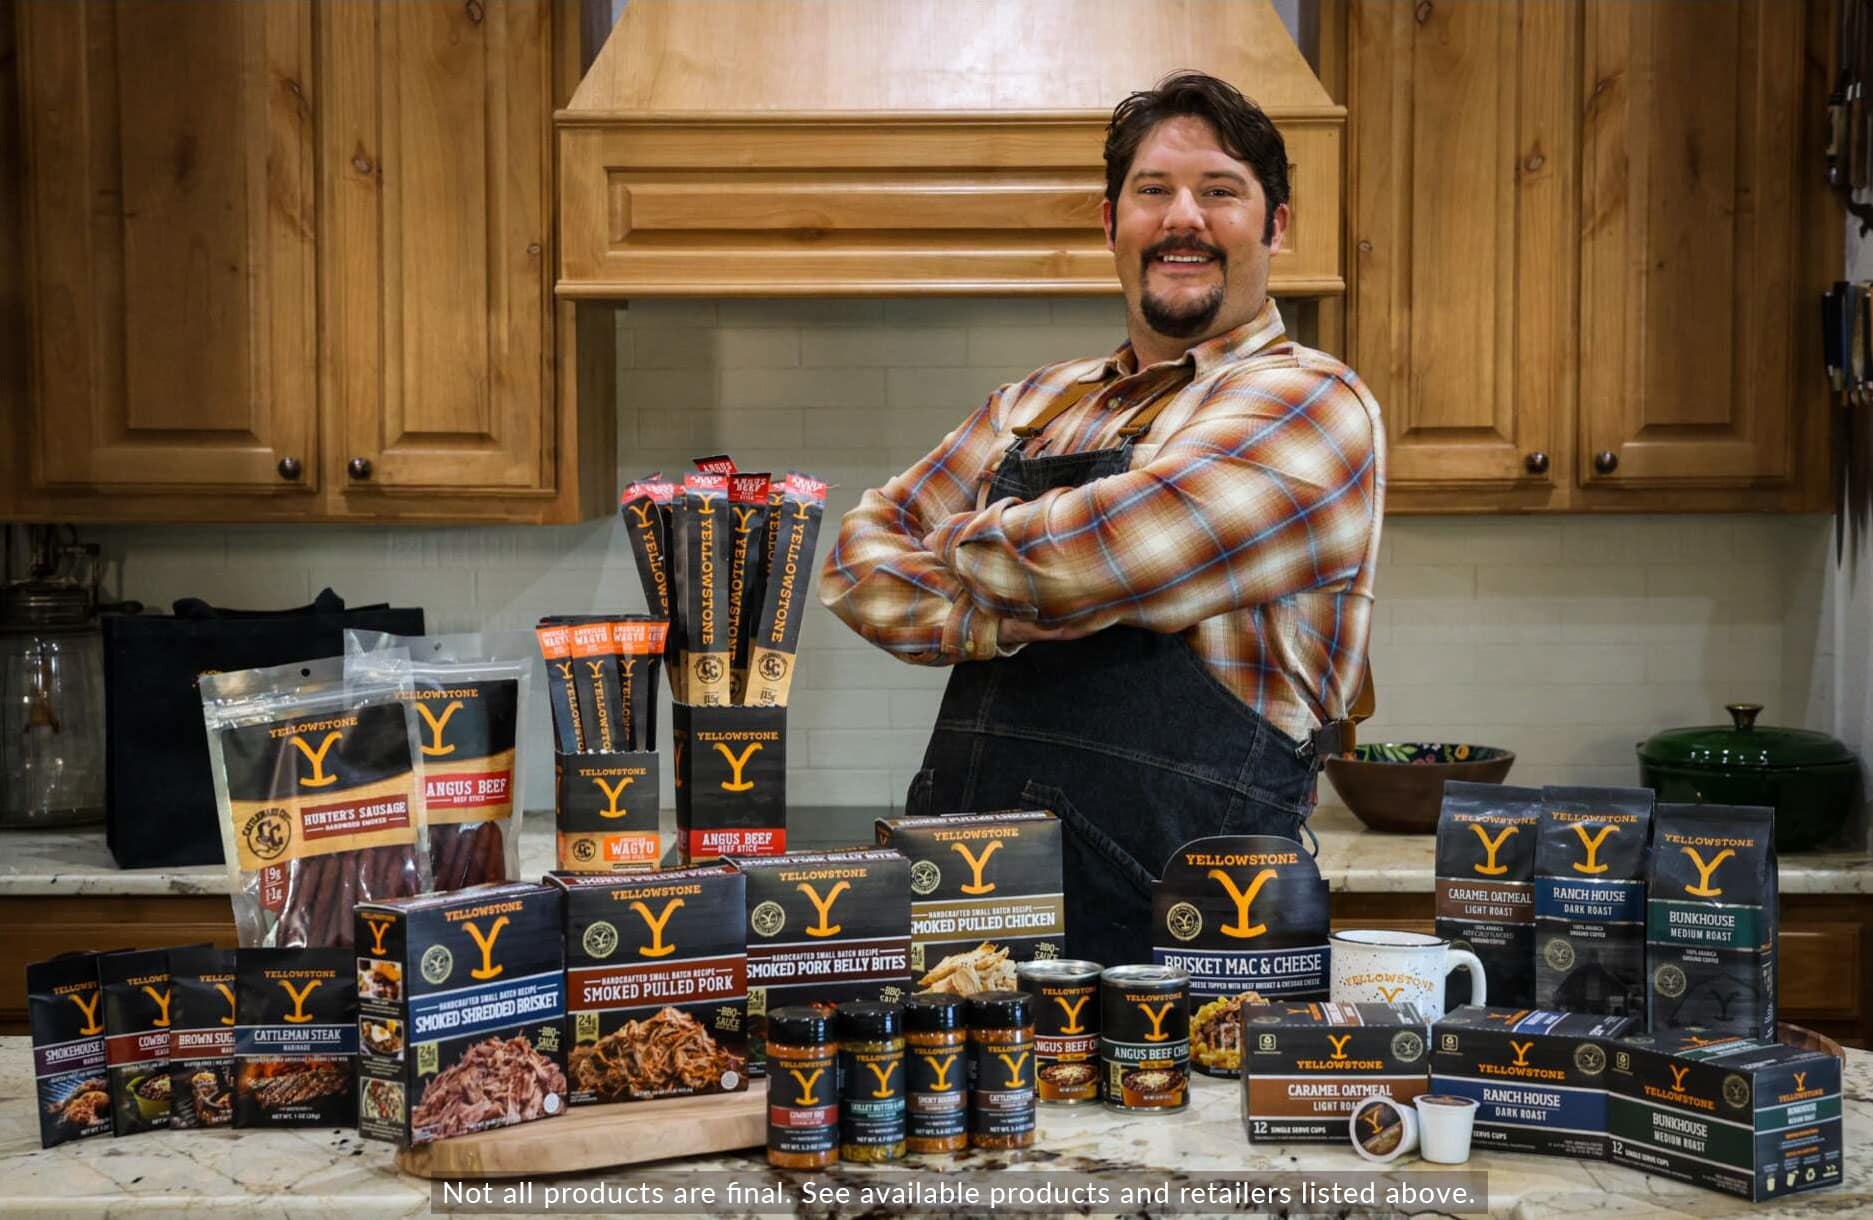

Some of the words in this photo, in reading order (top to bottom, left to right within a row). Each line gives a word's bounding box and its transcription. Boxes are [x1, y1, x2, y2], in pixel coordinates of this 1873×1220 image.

[701, 518, 714, 645] YELLOWSTONE
[771, 523, 804, 643] YELLOWSTONE
[566, 681, 584, 751] YELLOWSTO
[594, 679, 611, 751] YELLOWSTO
[269, 716, 358, 738] YELLOWSTONE
[697, 731, 779, 741] YELLOWSTONE
[579, 767, 646, 776] YELLOWSTONE
[426, 781, 472, 797] ANGUS
[478, 778, 507, 794] BEEF
[304, 809, 355, 826] HUNTER'S
[359, 802, 406, 818] SAUSAGE
[1454, 813, 1536, 825] YELLOWSTONE
[1551, 811, 1637, 823] YELLOWSTONE
[703, 833, 739, 846] ANGUS
[745, 832, 773, 844] BEEF
[933, 828, 1020, 841] YELLOWSTONE
[1664, 833, 1754, 847] YELLOWSTONE
[611, 841, 654, 854] WAGYU
[1185, 853, 1299, 866] YELLOWSTONE
[779, 868, 867, 881] YELLOWSTONE
[611, 885, 702, 900] YELLOWSTONE
[1449, 888, 1489, 901] CARAMEL
[1491, 891, 1531, 904] OATMEAL
[1553, 887, 1589, 900] RANCH
[1591, 889, 1625, 902] HOUSE
[445, 901, 523, 921] YELLOWSTONE
[928, 909, 971, 919] HANDCRAFTED
[972, 908, 991, 916] SMALL
[1465, 905, 1487, 915] LIGHT
[1489, 907, 1513, 917] ROAST
[1564, 904, 1585, 914] DARK
[1587, 905, 1612, 915] ROAST
[958, 916, 1002, 931] PULLED
[1005, 913, 1055, 928] CHICKEN
[1669, 911, 1735, 927] BUNKHOUSE
[1670, 928, 1703, 939] MEDIUM
[1706, 929, 1732, 941] ROAST
[772, 952, 815, 961] HANDCRAFTED
[816, 951, 836, 959] SMALL
[747, 963, 795, 979] SMOKED
[797, 960, 833, 976] PORK
[834, 957, 870, 973] BELLY
[872, 955, 906, 970] BITES
[1164, 955, 1222, 974] BRISKET
[1226, 957, 1257, 975] MAC
[1260, 957, 1271, 975] &
[1274, 954, 1322, 972] CHEESE
[264, 970, 336, 978] YELLOWSTONE
[602, 974, 647, 985] HANDCRAFTED
[649, 972, 670, 981] SMALL
[672, 970, 692, 980] BATCH
[583, 983, 639, 1002] SMOKED
[643, 980, 694, 998] PULLED
[698, 975, 733, 992] PORK
[1344, 973, 1435, 992] YELLOWSTONE
[1125, 992, 1183, 1002] YELLOWSTONE
[416, 1011, 460, 1034] SMOKED
[461, 1000, 515, 1024] SHREDDED
[516, 992, 559, 1015] BRISKET
[179, 1033, 213, 1045] BROWN
[215, 1031, 235, 1044] SUG
[254, 1029, 310, 1041] CATTLEMAN
[311, 1028, 341, 1040] STEAK
[45, 1041, 101, 1062] SMOKEHOUSE
[1065, 1040, 1088, 1051] BEEF
[1114, 1047, 1147, 1060] ANGUS
[1149, 1047, 1173, 1060] BEEF
[1297, 1060, 1383, 1070] YELLOWSTONE
[1478, 1063, 1566, 1080] YELLOWSTONE
[1288, 1084, 1340, 1097] CARAMEL
[1343, 1084, 1392, 1097] OATMEAL
[1483, 1088, 1522, 1104] RANCH
[1523, 1091, 1561, 1107] HOUSE
[1644, 1085, 1716, 1110] YELLOWSTONE
[1313, 1101, 1337, 1111] LIGHT
[1340, 1101, 1358, 1111] ROA
[1495, 1106, 1518, 1117] DARK
[1520, 1108, 1547, 1120] ROAST
[1254, 1122, 1268, 1134] 12
[1653, 1112, 1708, 1137] BUNKHOUSE
[1492, 1131, 1507, 1140] CUPS
[1654, 1131, 1682, 1146] MEDIUM
[1683, 1138, 1705, 1152] ROAST
[1612, 1141, 1623, 1154] 12
